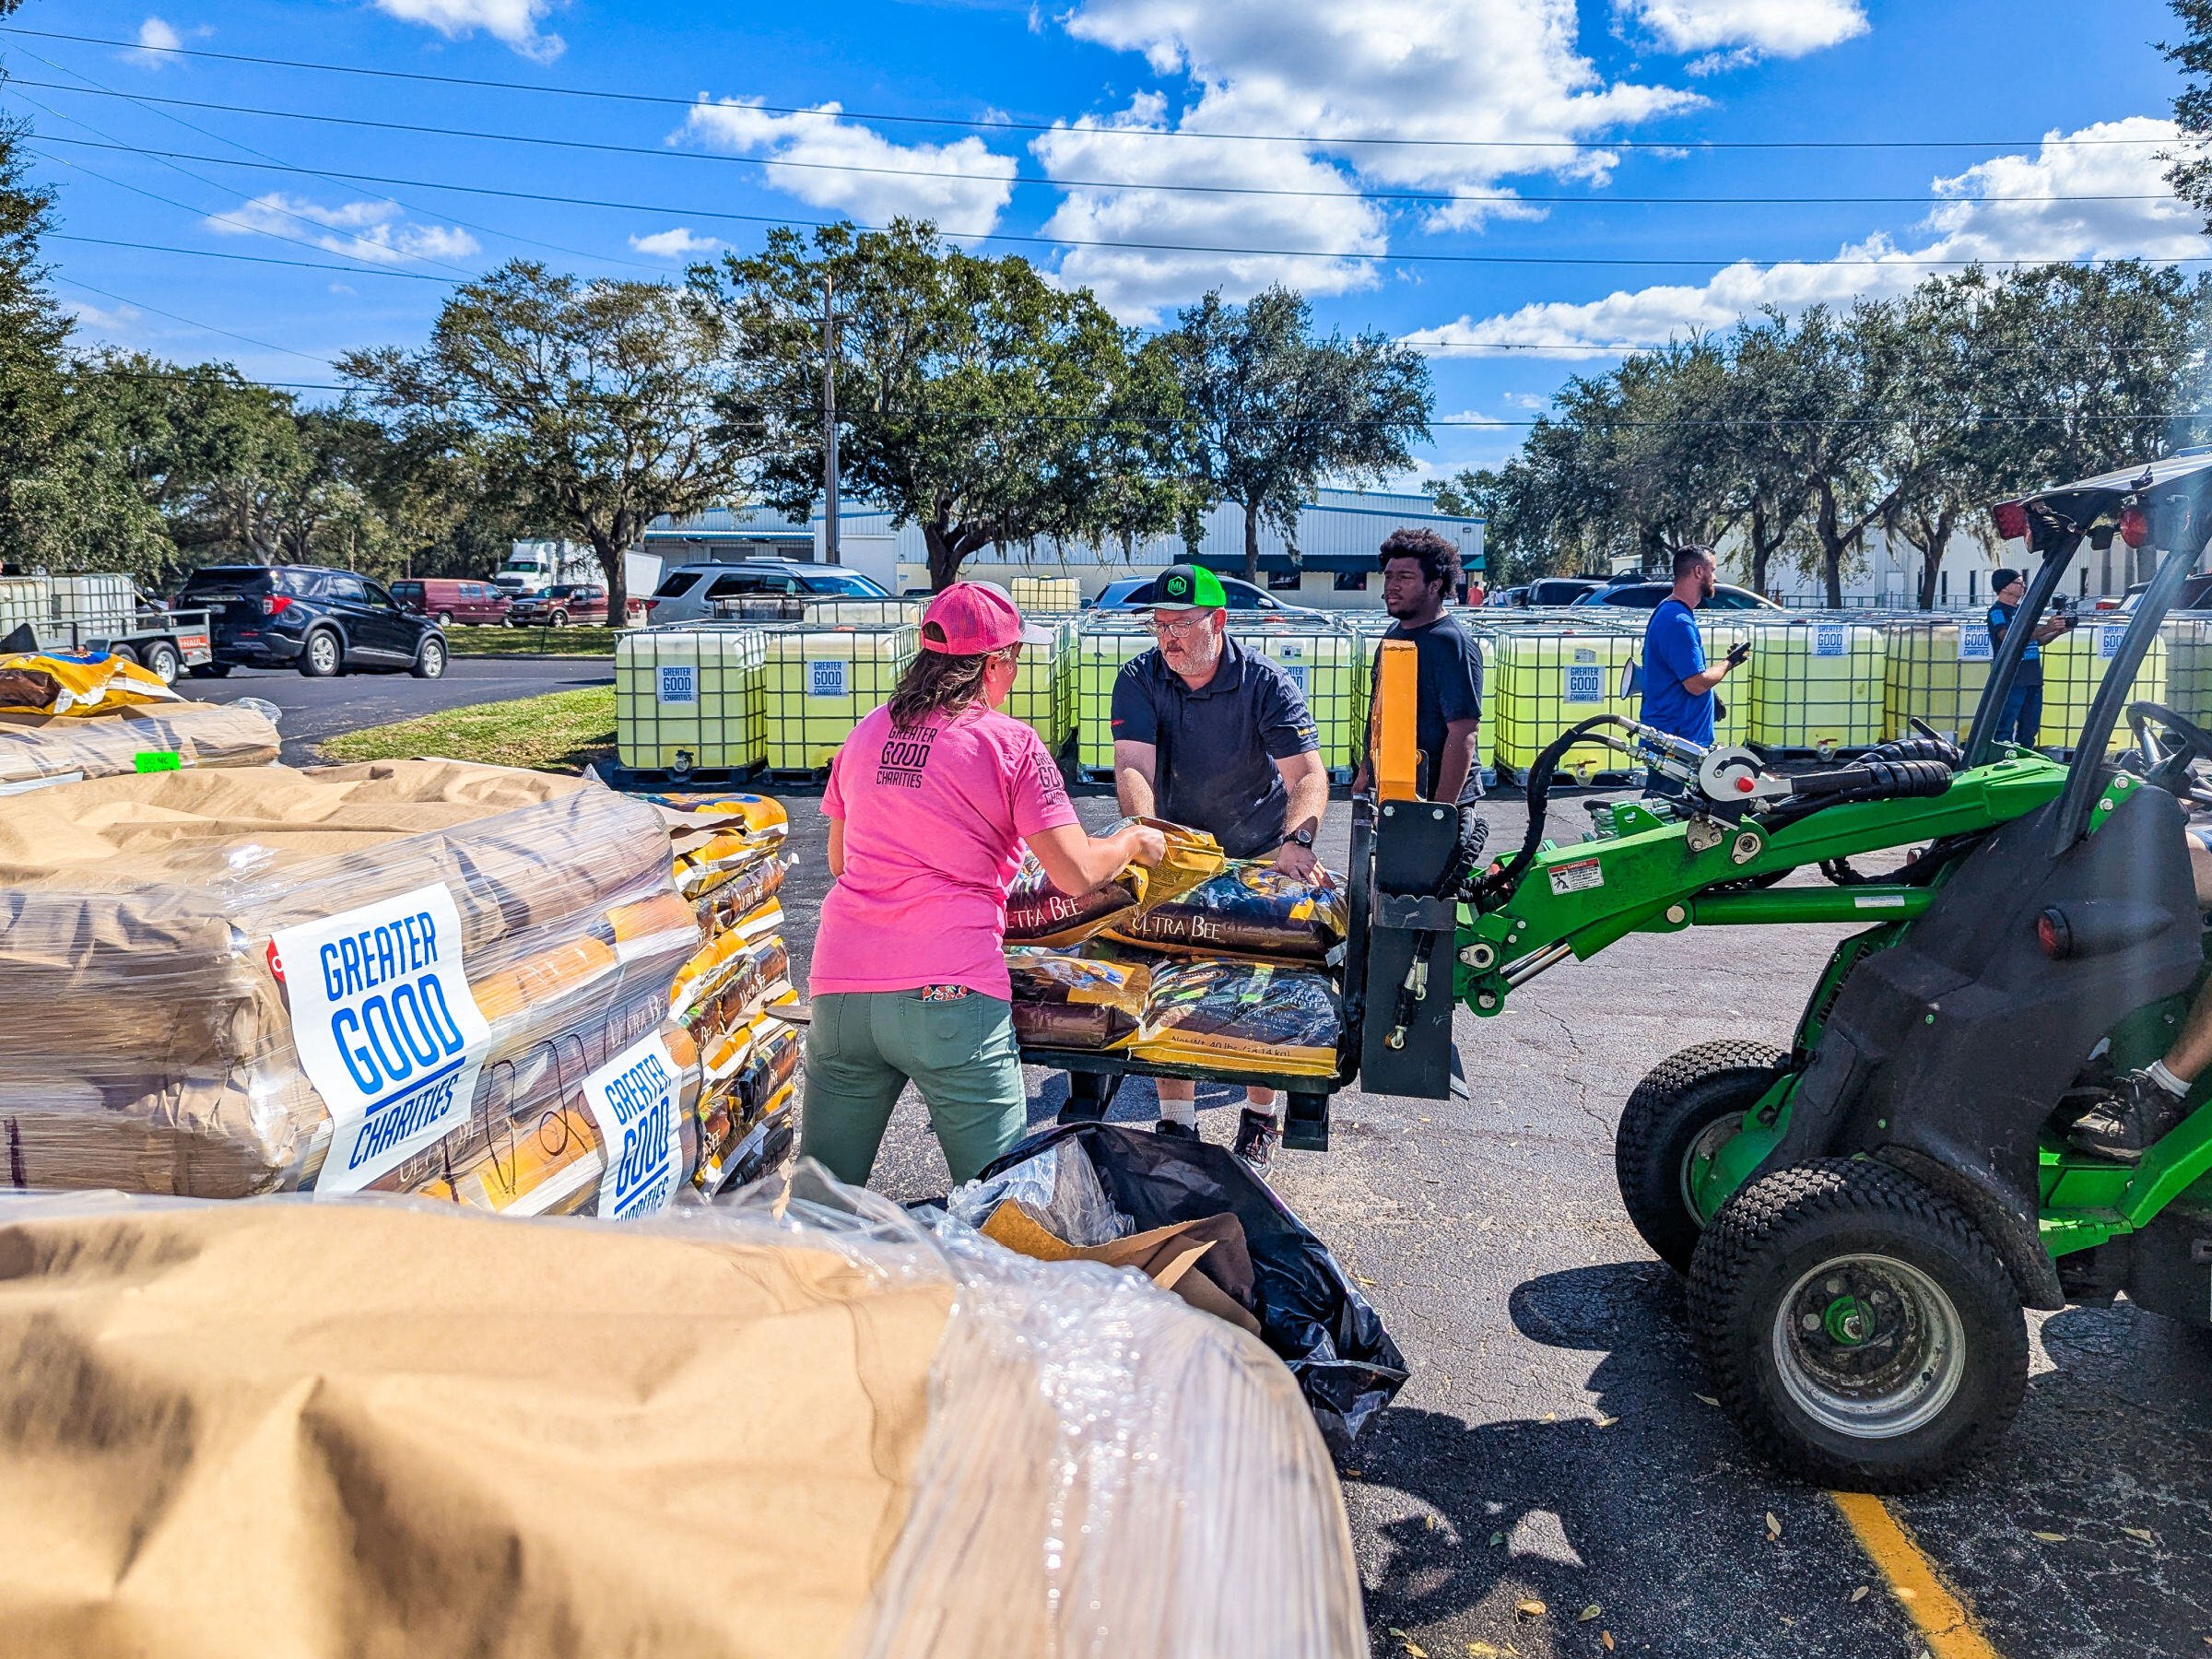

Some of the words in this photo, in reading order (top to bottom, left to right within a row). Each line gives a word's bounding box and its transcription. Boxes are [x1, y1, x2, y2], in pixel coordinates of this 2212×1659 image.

[1818, 625, 1843, 633] GREATER
[1818, 633, 1842, 646] GOOD
[1964, 634, 1990, 646] GOOD
[663, 666, 691, 677] GREATER
[813, 661, 842, 671] GREATER
[1571, 666, 1599, 677] GREATER
[663, 677, 691, 691] GOOD
[814, 671, 842, 686] GOOD
[1571, 677, 1599, 691] GOOD
[664, 693, 692, 701] CHARITIES
[814, 688, 842, 696] CHARITIES
[1570, 693, 1598, 701] CHARITIES
[888, 724, 937, 744] GREATER
[881, 741, 931, 769] GOOD
[876, 770, 923, 789] CHARITIES
[1005, 908, 1048, 930] LTRA
[1049, 896, 1084, 923] BEE
[1191, 915, 1221, 940] BEE
[320, 911, 439, 1002] GREATER
[331, 973, 465, 1096] GOOD
[605, 1053, 672, 1126] GREATER
[348, 1073, 460, 1171] CHARITIES
[616, 1095, 670, 1199] GOOD
